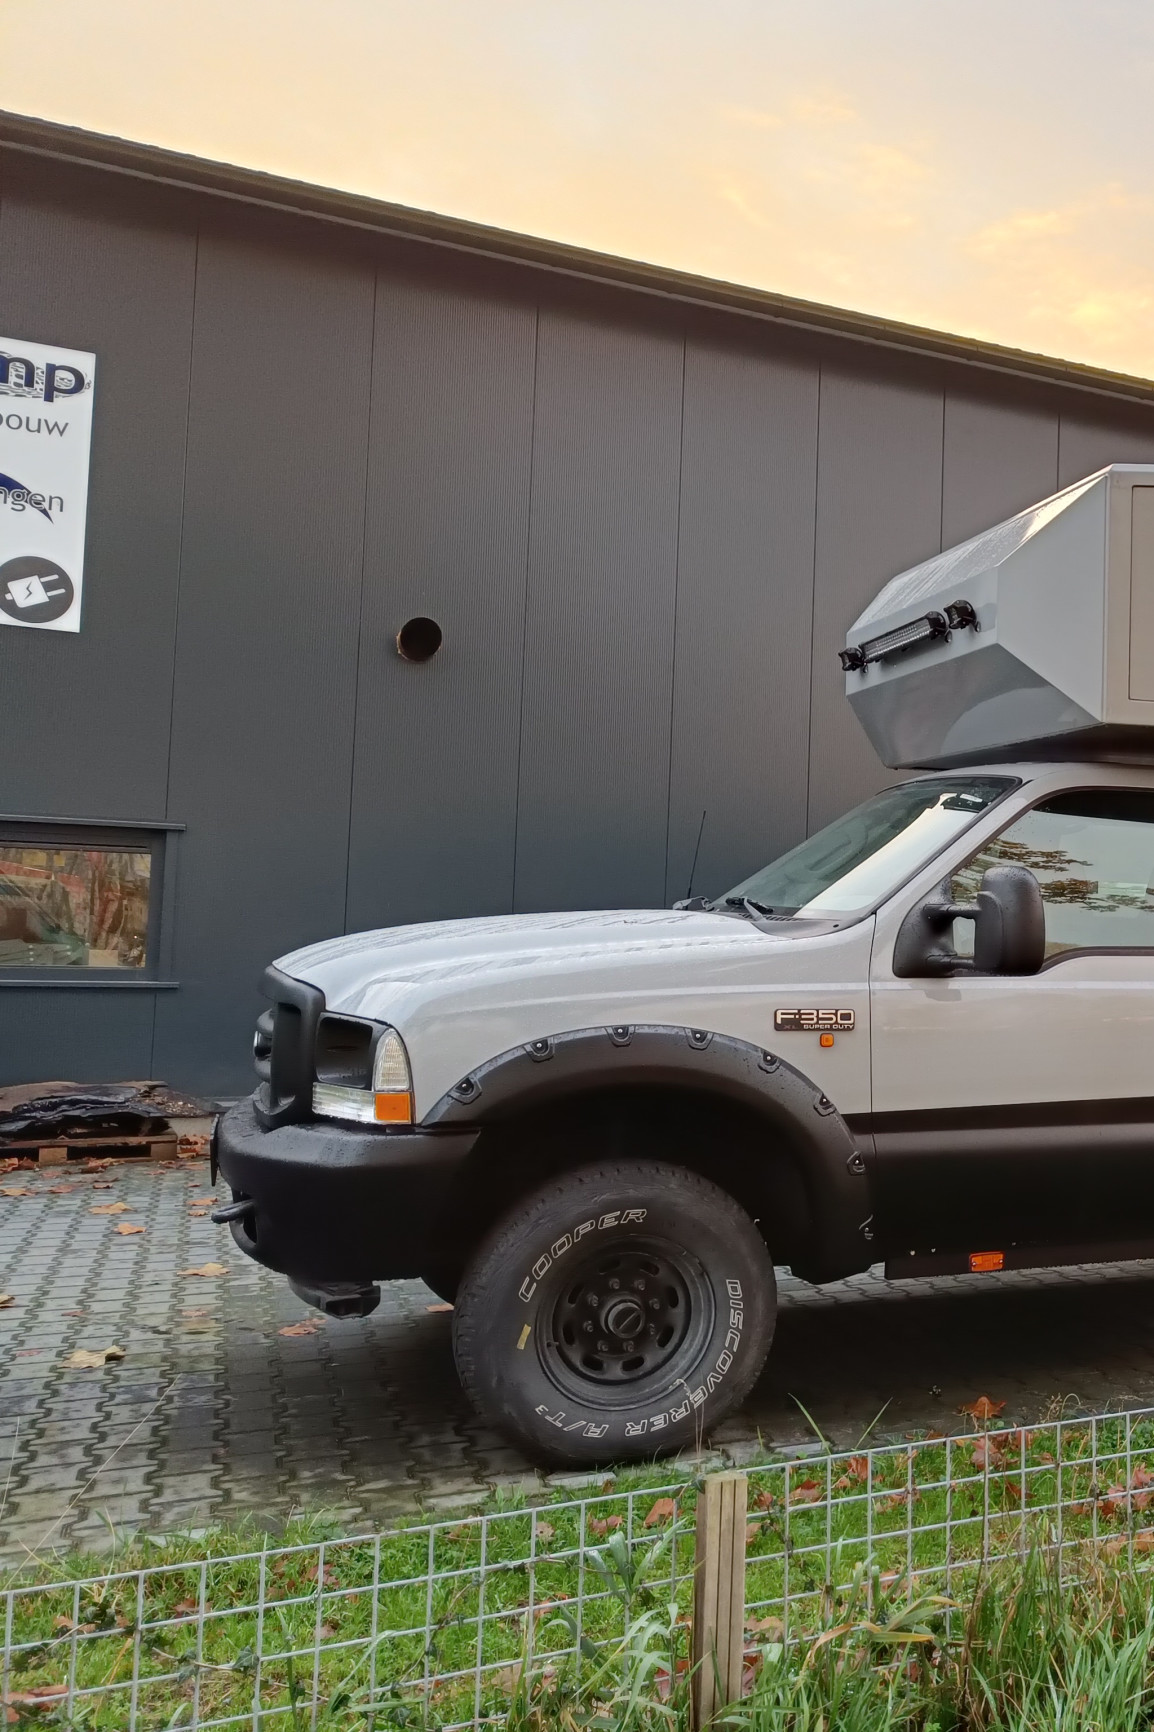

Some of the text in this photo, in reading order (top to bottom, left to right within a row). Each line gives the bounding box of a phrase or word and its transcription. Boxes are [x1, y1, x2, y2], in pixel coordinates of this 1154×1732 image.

[0, 413, 69, 437] ouw
[518, 1208, 648, 1303] COOPER
[624, 1279, 744, 1437] DISCOVERER
